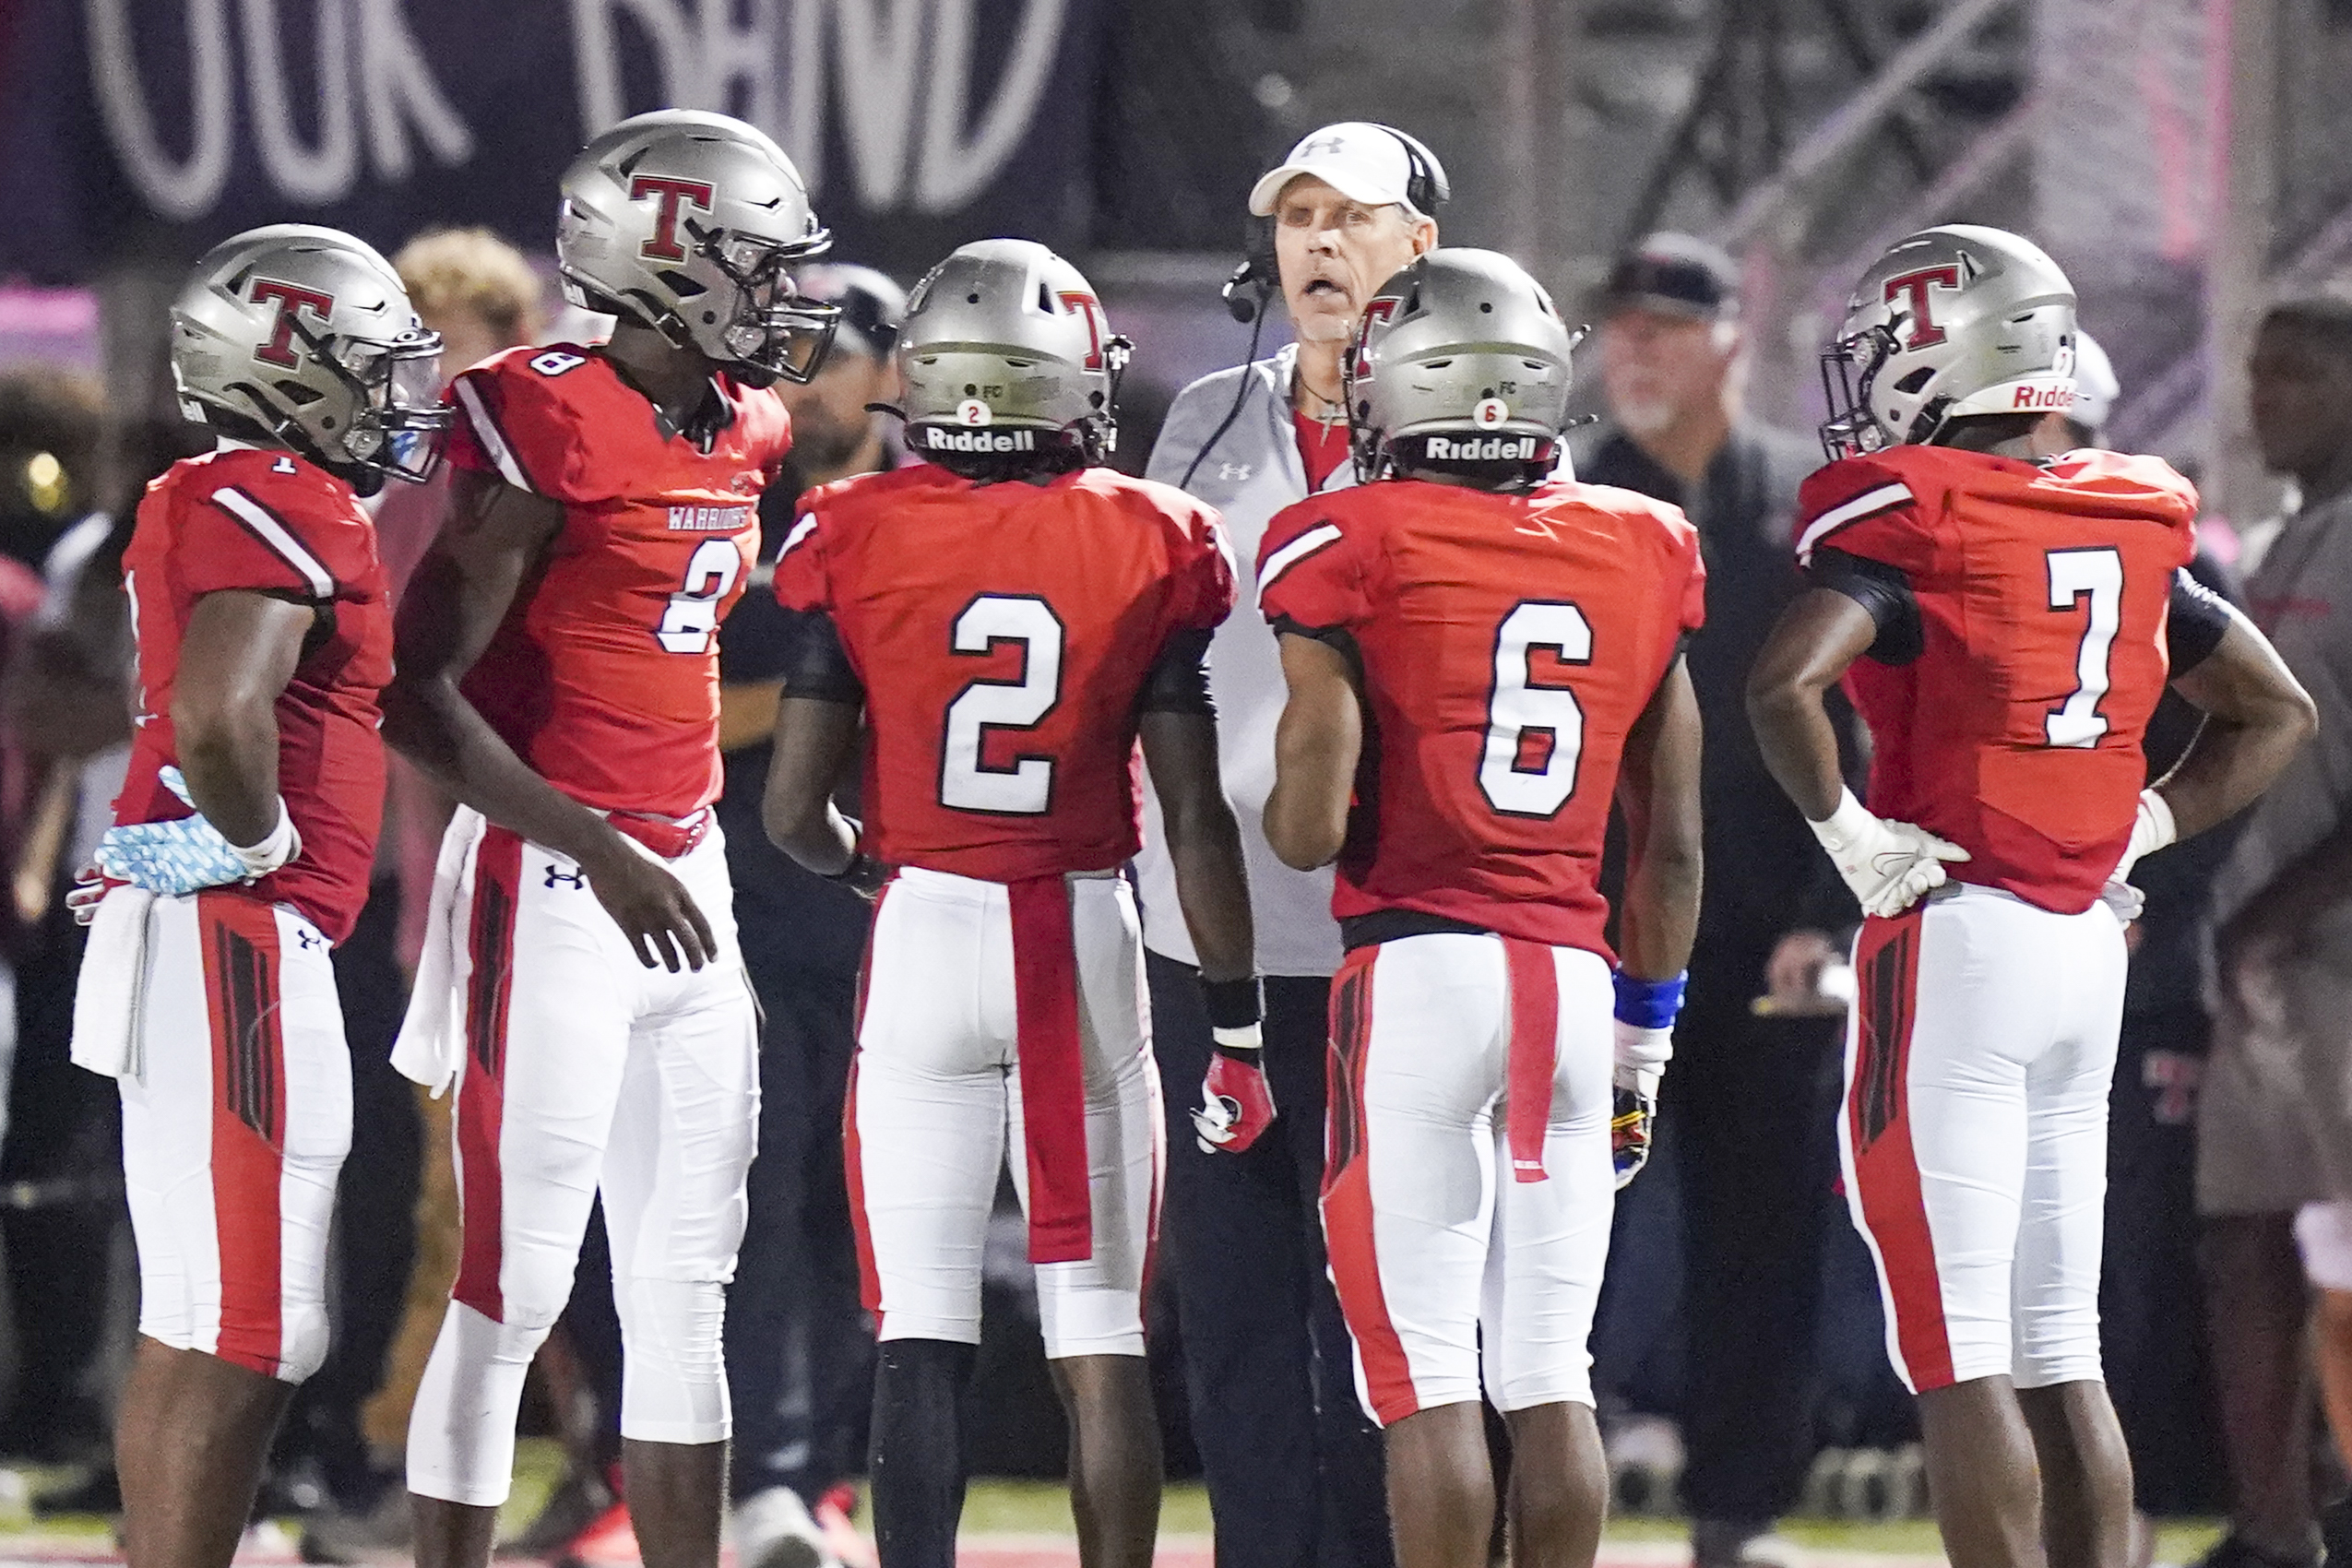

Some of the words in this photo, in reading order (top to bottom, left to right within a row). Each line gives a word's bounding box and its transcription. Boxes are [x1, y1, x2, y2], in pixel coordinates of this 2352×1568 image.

[628, 172, 718, 266] T
[246, 275, 336, 370] T
[1056, 291, 1105, 375] T
[1881, 259, 1966, 353] T
[926, 426, 1035, 452] Riddell
[968, 406, 980, 423] 2
[1426, 437, 1537, 460] Riddell
[1485, 405, 1497, 422] 6
[2044, 545, 2126, 751] 7
[938, 591, 1066, 817] 2
[1477, 600, 1594, 822] 6
